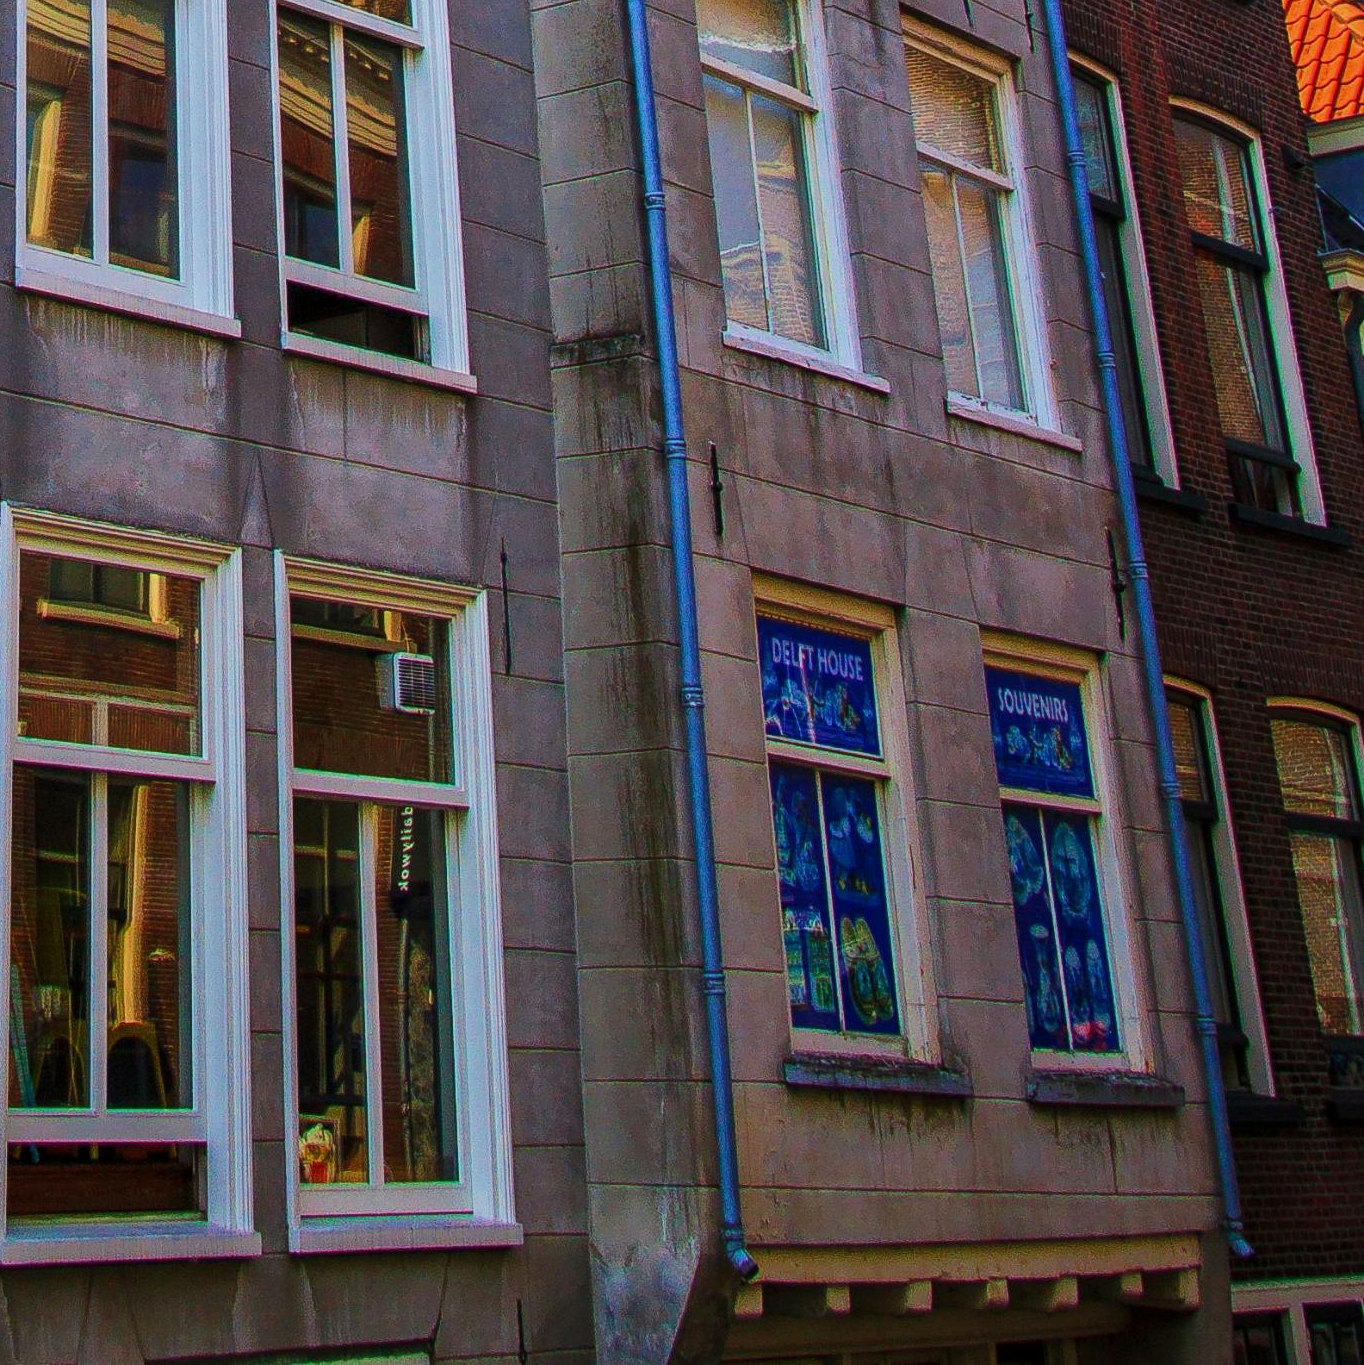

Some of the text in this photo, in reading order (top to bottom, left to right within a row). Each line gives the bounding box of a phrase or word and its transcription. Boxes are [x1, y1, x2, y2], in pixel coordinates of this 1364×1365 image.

[771, 637, 864, 682] DELFT HOUSE
[997, 686, 1069, 723] SOUVENIRS
